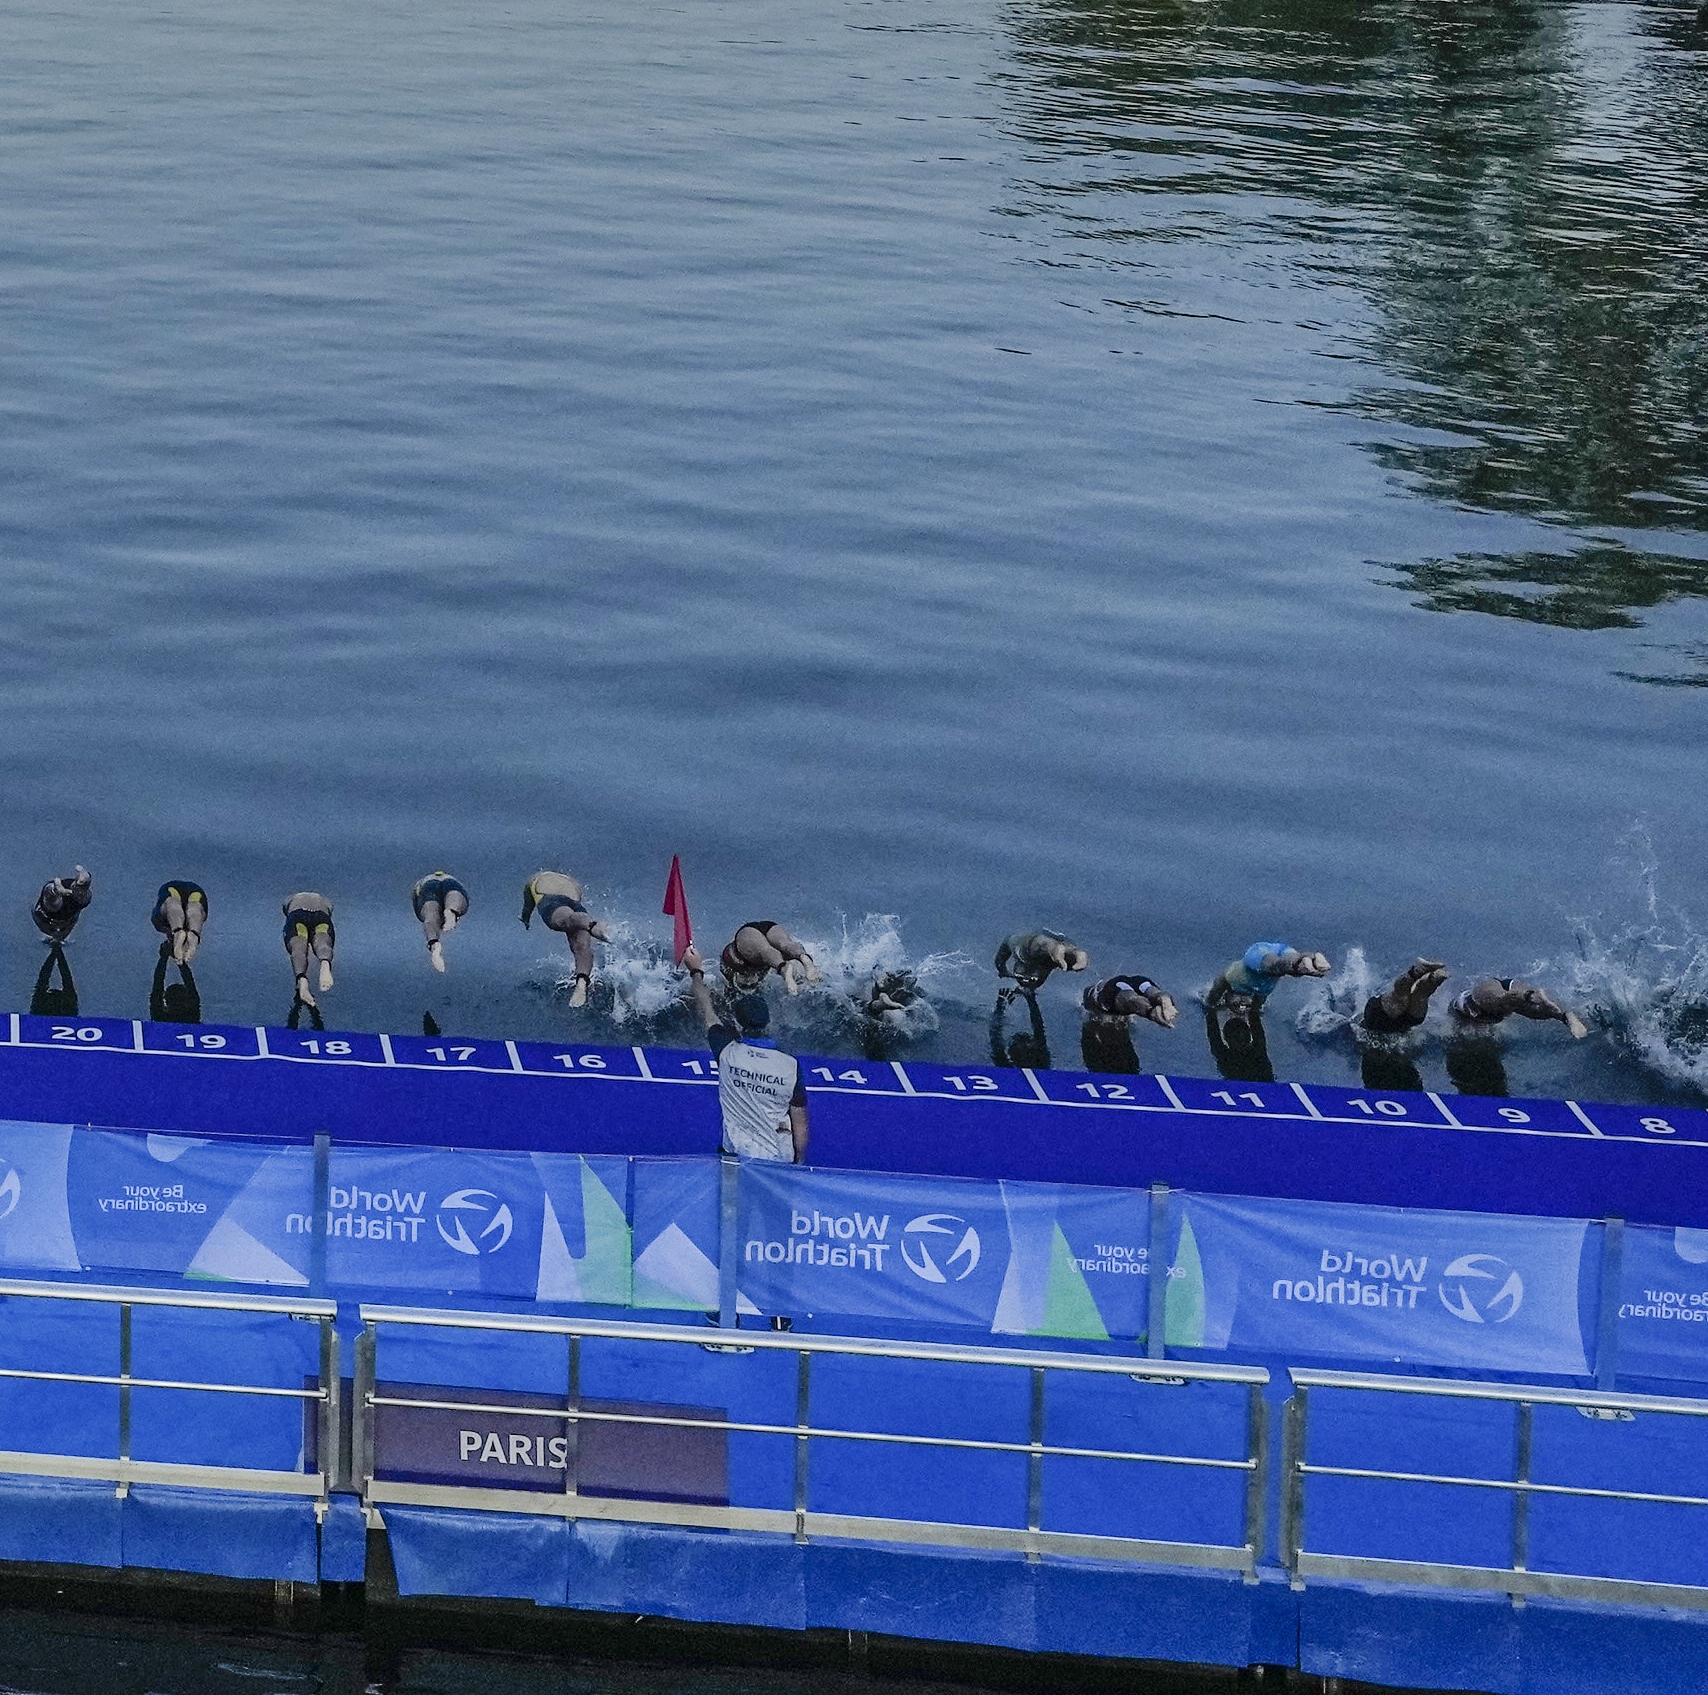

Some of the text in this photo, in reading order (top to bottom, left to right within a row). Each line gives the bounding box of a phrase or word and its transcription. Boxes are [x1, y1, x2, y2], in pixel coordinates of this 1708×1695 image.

[51, 1026, 103, 1042] 20
[175, 1034, 227, 1049] 19
[299, 1040, 352, 1055] 18
[426, 1046, 477, 1062] 17
[553, 1054, 607, 1069] 16
[728, 1066, 786, 1086] TECHNICAL
[811, 1067, 868, 1085] 14
[942, 1075, 999, 1091] 13
[733, 1079, 778, 1096] OFFICIAL
[1075, 1083, 1135, 1100] 12
[1210, 1091, 1265, 1108] 11
[1346, 1099, 1407, 1116] 10
[1498, 1107, 1531, 1123] 9
[1639, 1117, 1676, 1134] 8
[459, 1430, 568, 1469] PARIS
